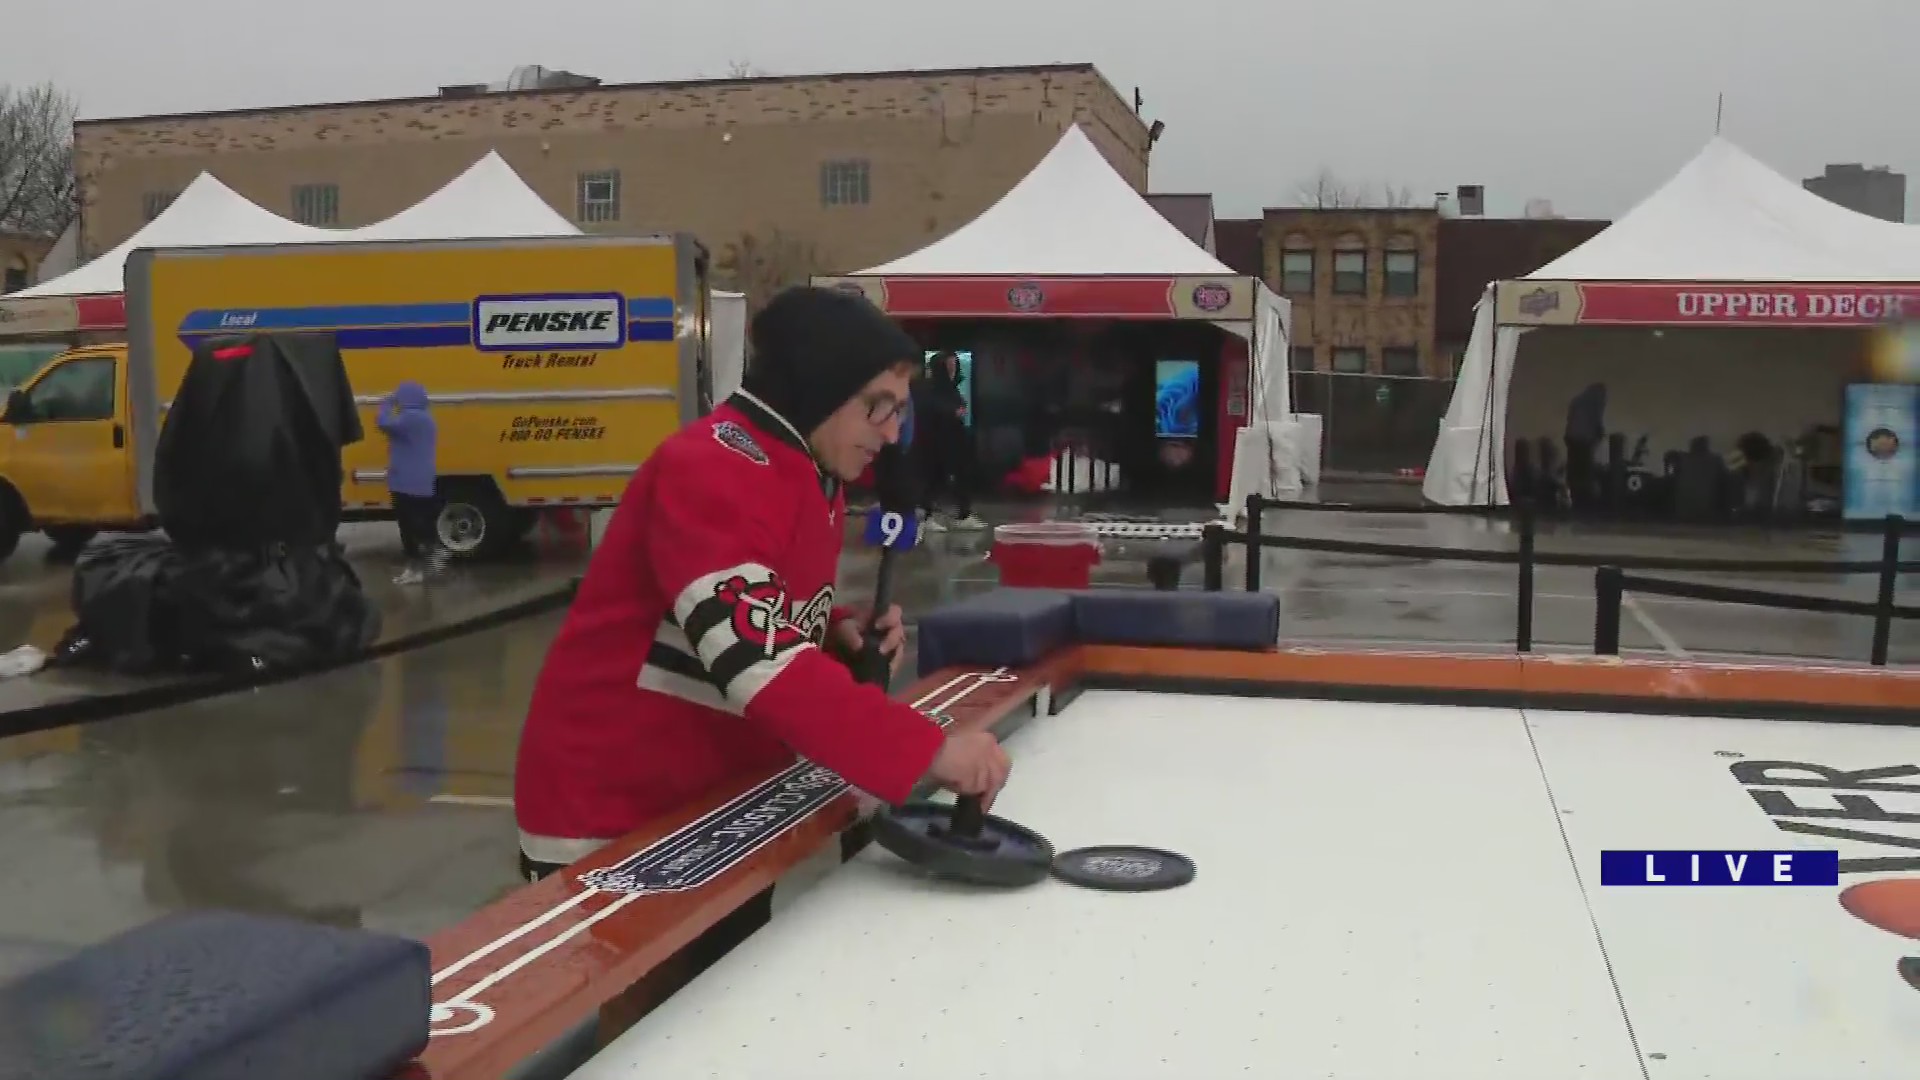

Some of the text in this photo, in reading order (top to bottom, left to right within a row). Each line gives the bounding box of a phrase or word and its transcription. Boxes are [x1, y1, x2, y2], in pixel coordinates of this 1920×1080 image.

[1677, 292, 1905, 318] UPPER DECK
[485, 310, 613, 333] PENSKE
[502, 352, 597, 369] Truck Rental
[880, 512, 904, 546] 9
